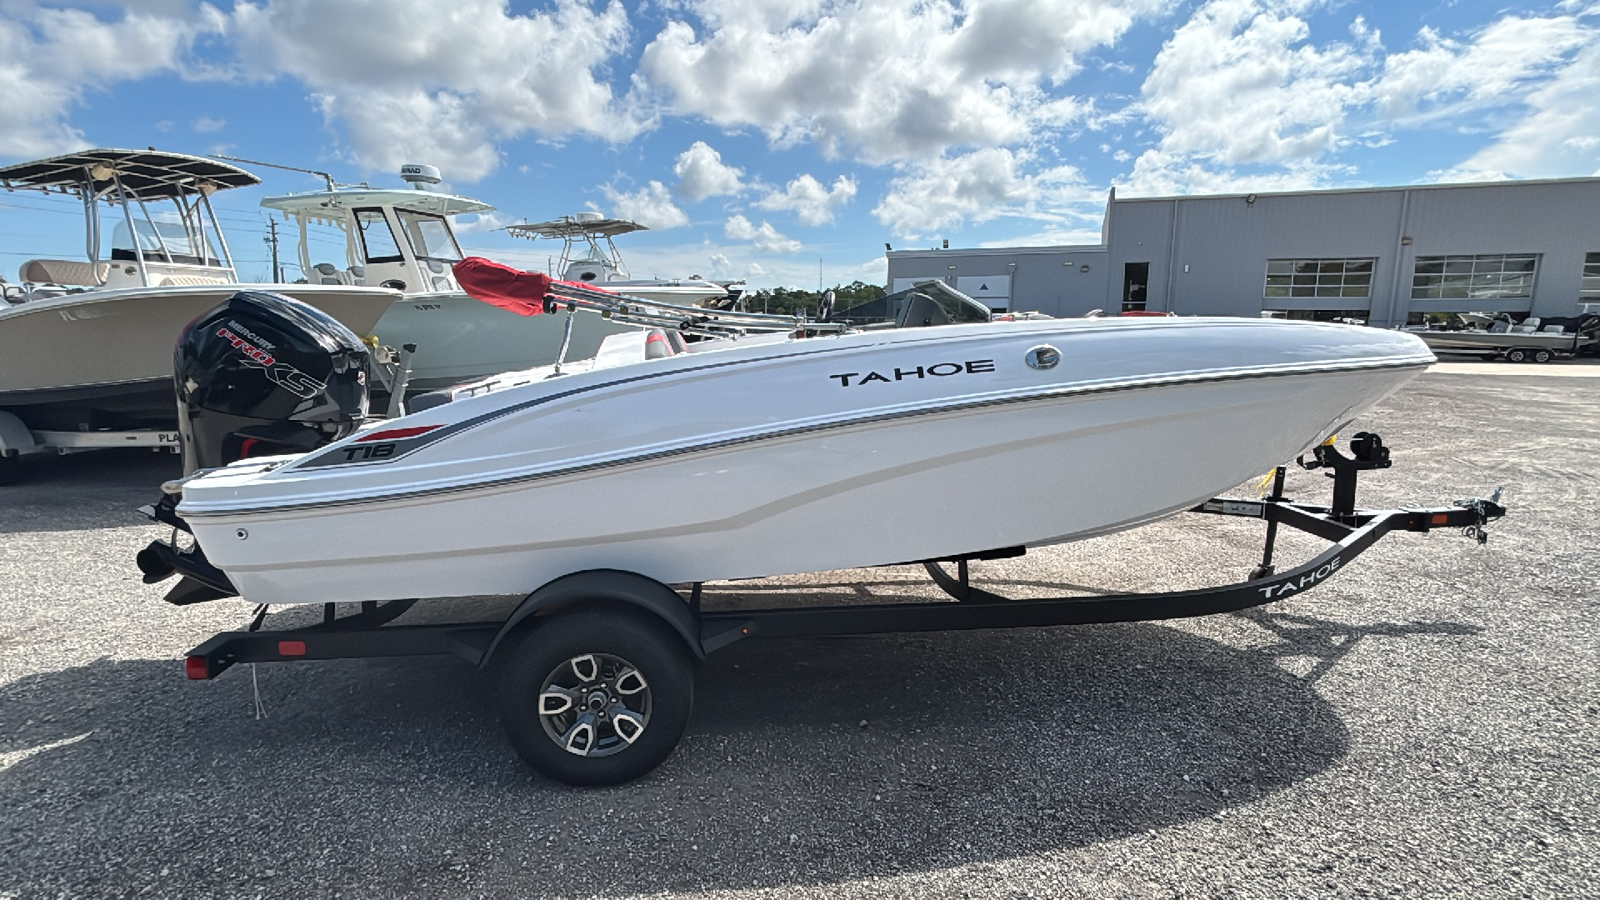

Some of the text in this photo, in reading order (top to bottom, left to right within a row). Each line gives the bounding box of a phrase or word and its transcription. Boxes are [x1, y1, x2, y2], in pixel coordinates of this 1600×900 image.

[228, 320, 276, 349] MERCURY
[216, 327, 327, 399] PRO XS
[829, 359, 996, 387] TAHOE
[342, 443, 396, 461] T18
[1258, 556, 1341, 599] TAHOE
